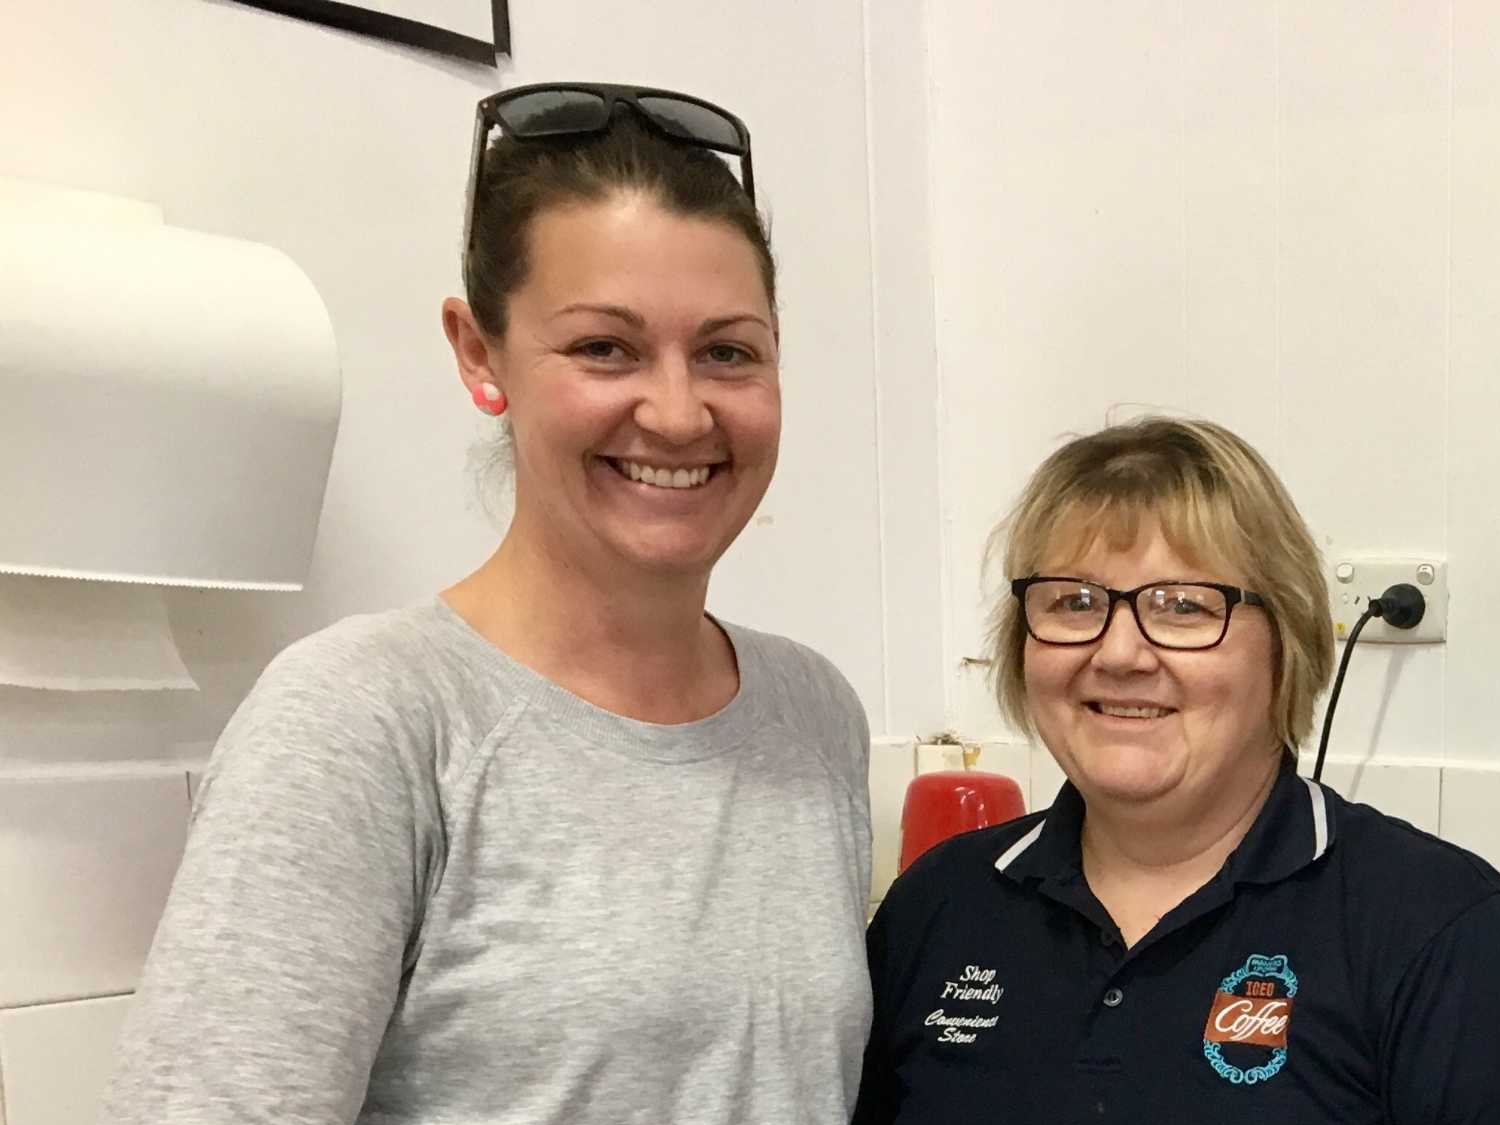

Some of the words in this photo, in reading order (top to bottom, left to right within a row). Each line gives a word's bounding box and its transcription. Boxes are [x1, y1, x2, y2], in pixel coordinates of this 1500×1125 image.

[960, 965, 996, 984] Shop
[940, 981, 1004, 1005] Friendly
[1246, 981, 1275, 997] ICED
[1215, 1000, 1289, 1041] Coffee
